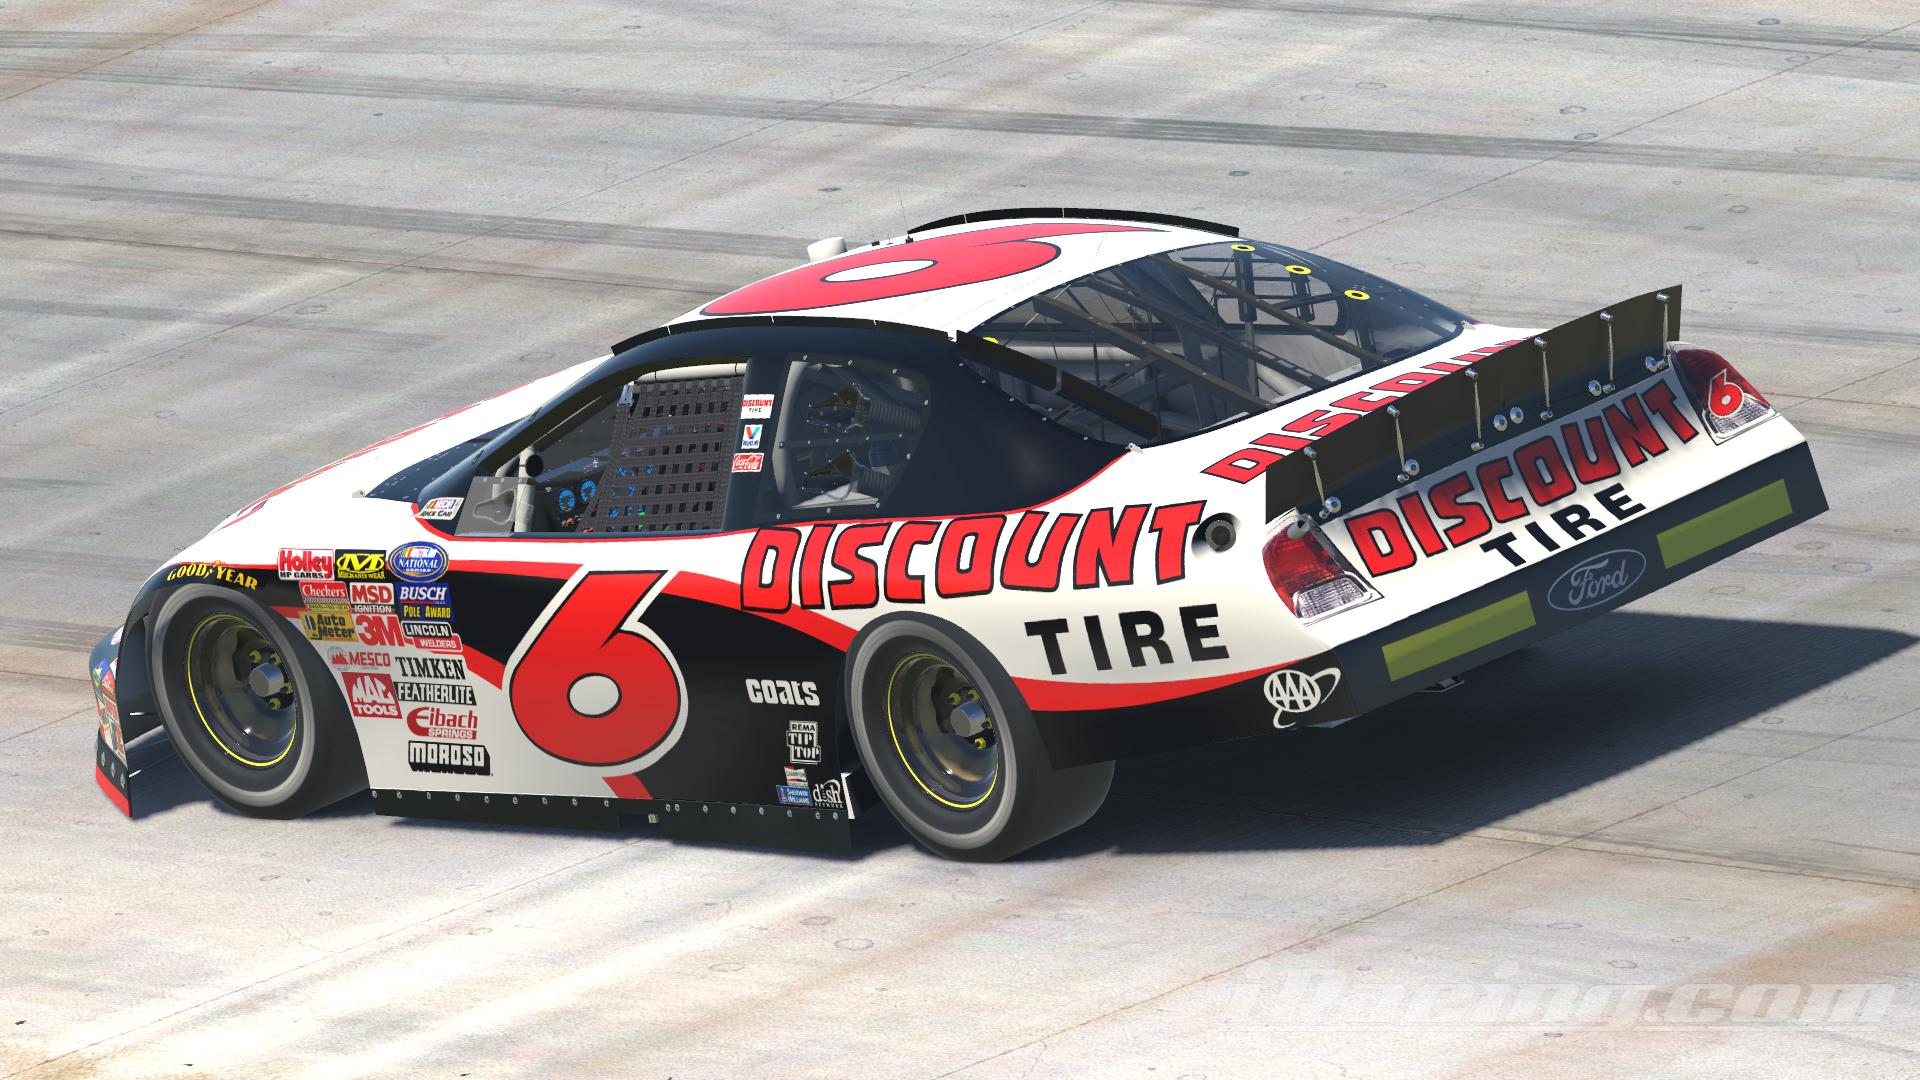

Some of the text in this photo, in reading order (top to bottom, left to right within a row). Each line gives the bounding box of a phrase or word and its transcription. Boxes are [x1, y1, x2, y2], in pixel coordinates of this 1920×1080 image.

[741, 399, 773, 407] DISCOUNT
[1708, 368, 1745, 418] 6
[1200, 336, 1530, 484] DISCO
[1344, 379, 1700, 577] DISCOUNT
[1480, 483, 1647, 568] TIRE
[280, 550, 333, 579] Holley
[398, 558, 439, 569] NATIONAL
[740, 500, 1207, 613] DISCOUNT
[302, 584, 346, 598] Checkers
[1568, 558, 1630, 606] Ford
[351, 584, 393, 604] MSD
[400, 586, 448, 601] BUSCH
[354, 605, 392, 613] IGNITION
[317, 614, 346, 626] Auto
[404, 623, 450, 637] LINCOLN
[318, 626, 355, 641] Meter
[355, 614, 405, 648] 3M
[1024, 603, 1230, 675] TIRE
[420, 639, 457, 649] WELDERS
[348, 651, 391, 668] MESCO
[395, 656, 467, 681] TIMKEN
[508, 569, 682, 768] 6
[398, 682, 474, 706] FEATHERLITE
[1267, 670, 1318, 711] AAA
[354, 703, 399, 717] TOOLS
[407, 706, 479, 737] Eibach
[791, 723, 816, 732] REMA
[428, 728, 474, 740] SPRINGS
[788, 732, 814, 746] TIP
[794, 746, 821, 760] TOP
[813, 781, 843, 804] dish
